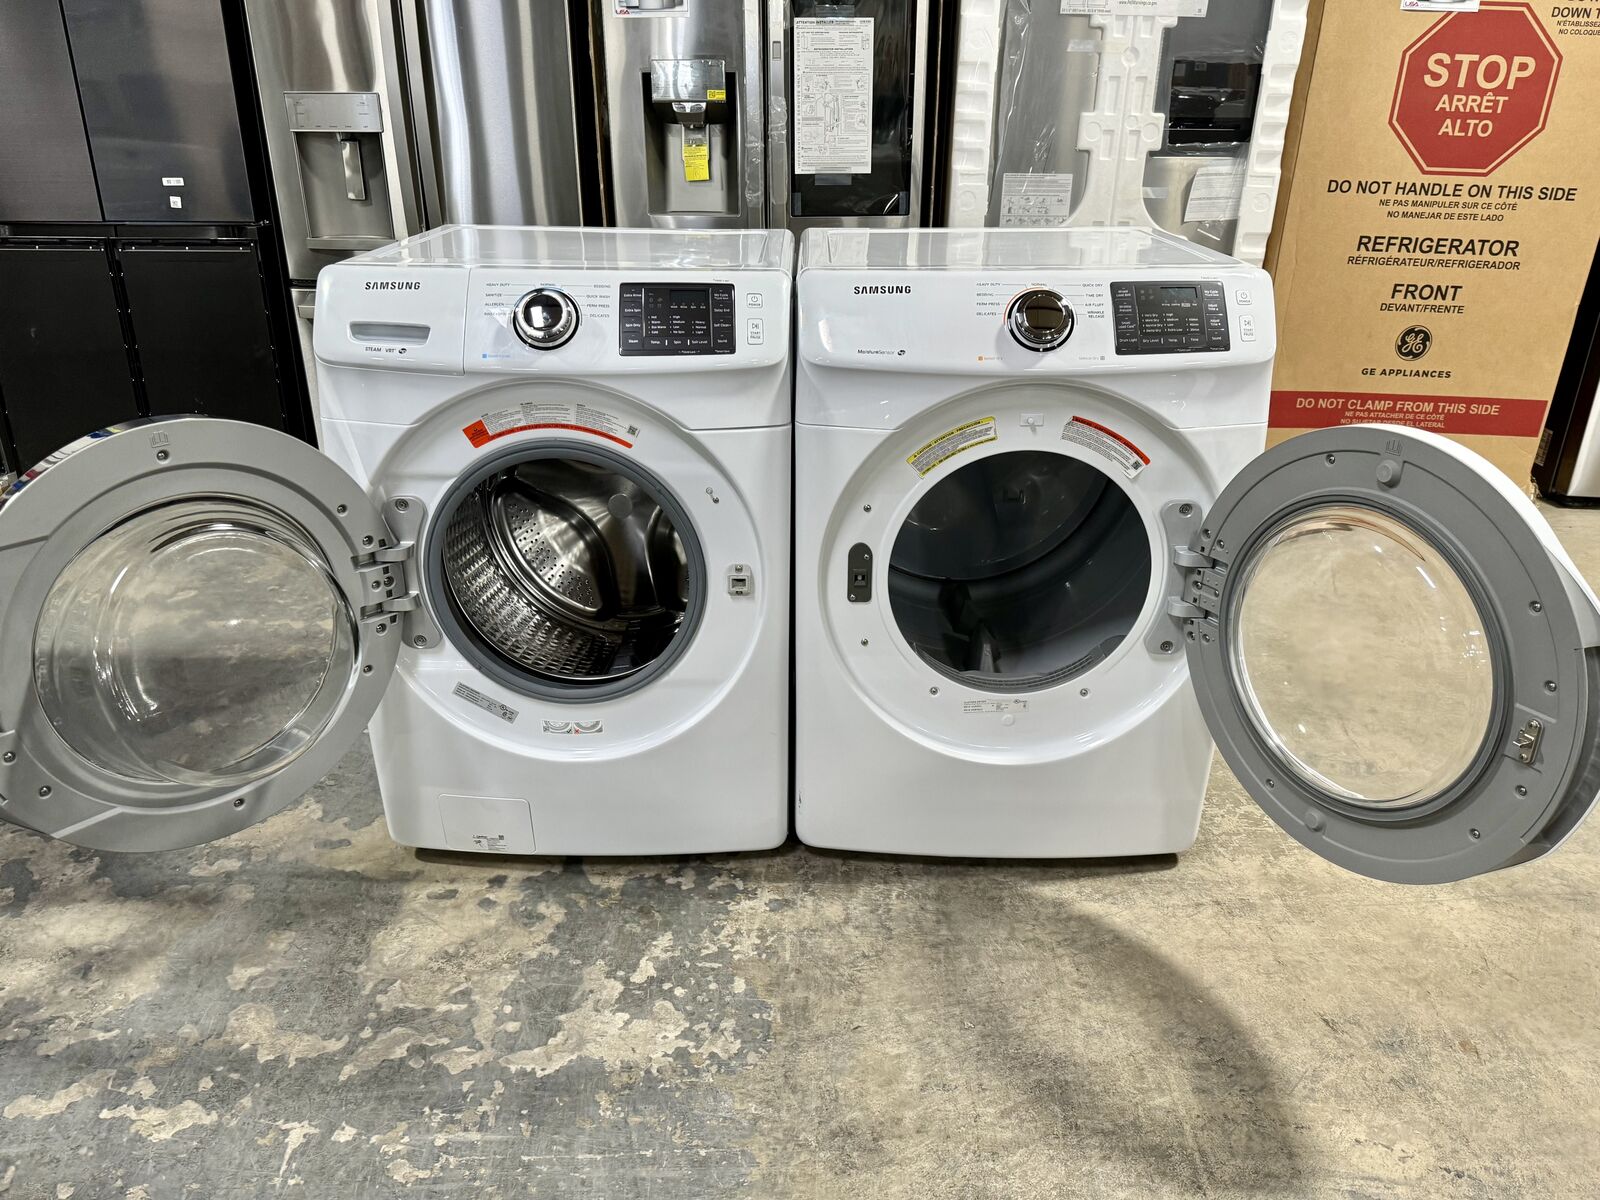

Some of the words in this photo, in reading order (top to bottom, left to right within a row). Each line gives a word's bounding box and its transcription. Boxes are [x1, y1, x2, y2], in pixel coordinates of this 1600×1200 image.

[1551, 6, 1593, 19] DOWN
[1423, 52, 1537, 91] STOP
[1434, 91, 1510, 114] ARRÊT
[1437, 118, 1494, 138] ALTO
[1327, 180, 1352, 194] DO
[1356, 180, 1392, 196] NOT
[1394, 182, 1464, 198] HANDLE
[1468, 184, 1492, 198] ON
[1498, 185, 1534, 200] THIS
[1538, 186, 1578, 202] SIDE
[1378, 199, 1392, 207] NE
[1410, 200, 1459, 208] MANIPULER
[1461, 202, 1479, 210] SUR
[1494, 202, 1518, 211] CÔTÉ
[1386, 210, 1400, 218] NO
[1400, 211, 1442, 220] MANEJAR
[1356, 235, 1520, 257] REFRIGERATOR
[1347, 255, 1520, 270] RÉFRIGÉRATEUR/REFRIGERADOR
[364, 281, 421, 291] SAMSUNG
[853, 285, 912, 295] SAMSUNG
[1390, 283, 1464, 302] FRONT
[1380, 302, 1465, 314] DEVANT/FRENTE
[1361, 368, 1376, 376] GE
[1380, 368, 1452, 379] APPLIANCES
[1296, 398, 1315, 409] DO
[1317, 398, 1345, 410] NOT
[1347, 400, 1394, 412] CLAMP
[1396, 401, 1434, 412] FROM
[1438, 402, 1466, 414] THIS
[1469, 404, 1501, 416] SIDE
[1416, 421, 1445, 429] LATERAL
